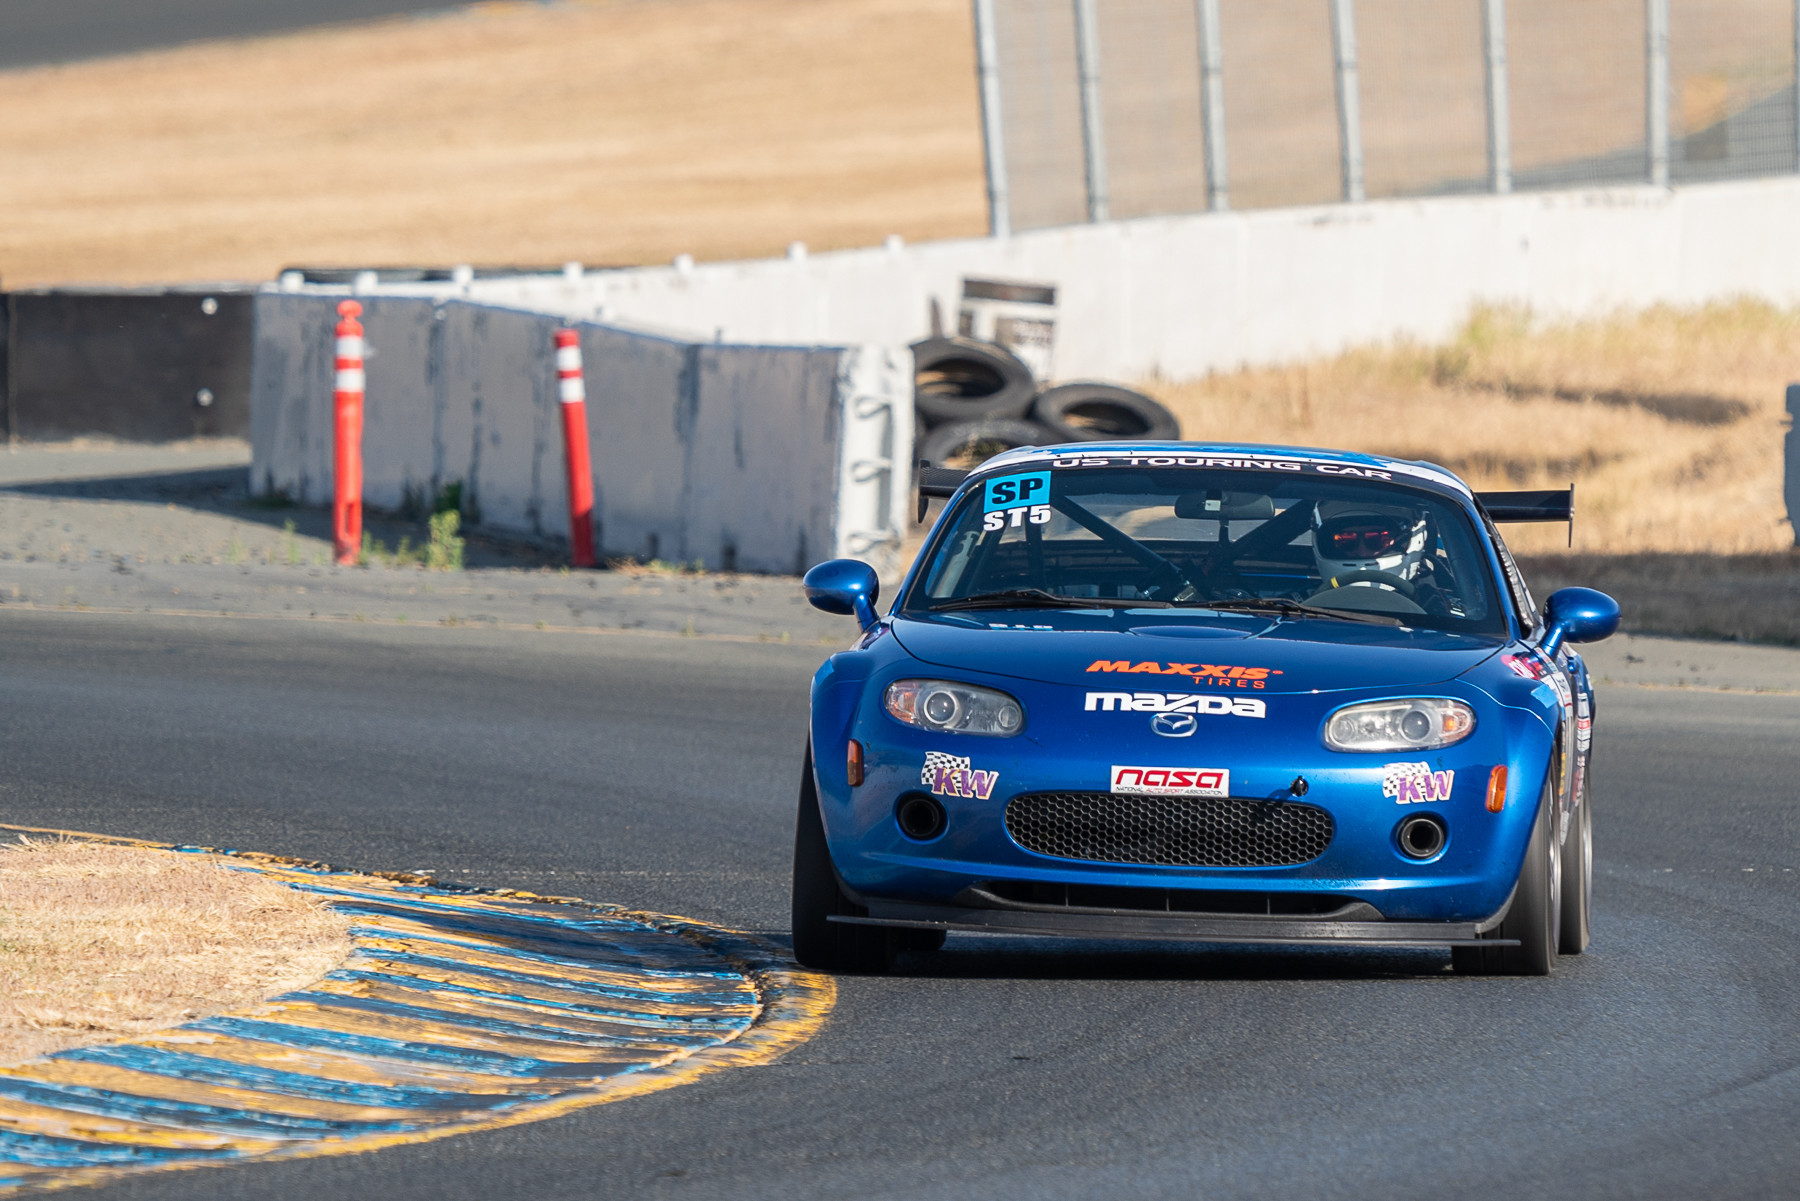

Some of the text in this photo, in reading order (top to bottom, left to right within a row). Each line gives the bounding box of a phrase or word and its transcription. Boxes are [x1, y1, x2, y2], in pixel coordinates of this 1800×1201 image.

[1053, 457, 1392, 480] US TOURING CAR
[992, 478, 1043, 504] SP
[983, 504, 1051, 531] ST5
[1086, 660, 1270, 679] MAXXIS
[1192, 676, 1266, 689] TIRES
[1084, 692, 1266, 719] mazda
[932, 766, 999, 800] KW
[1115, 769, 1224, 789] nasa
[1396, 770, 1455, 804] KW
